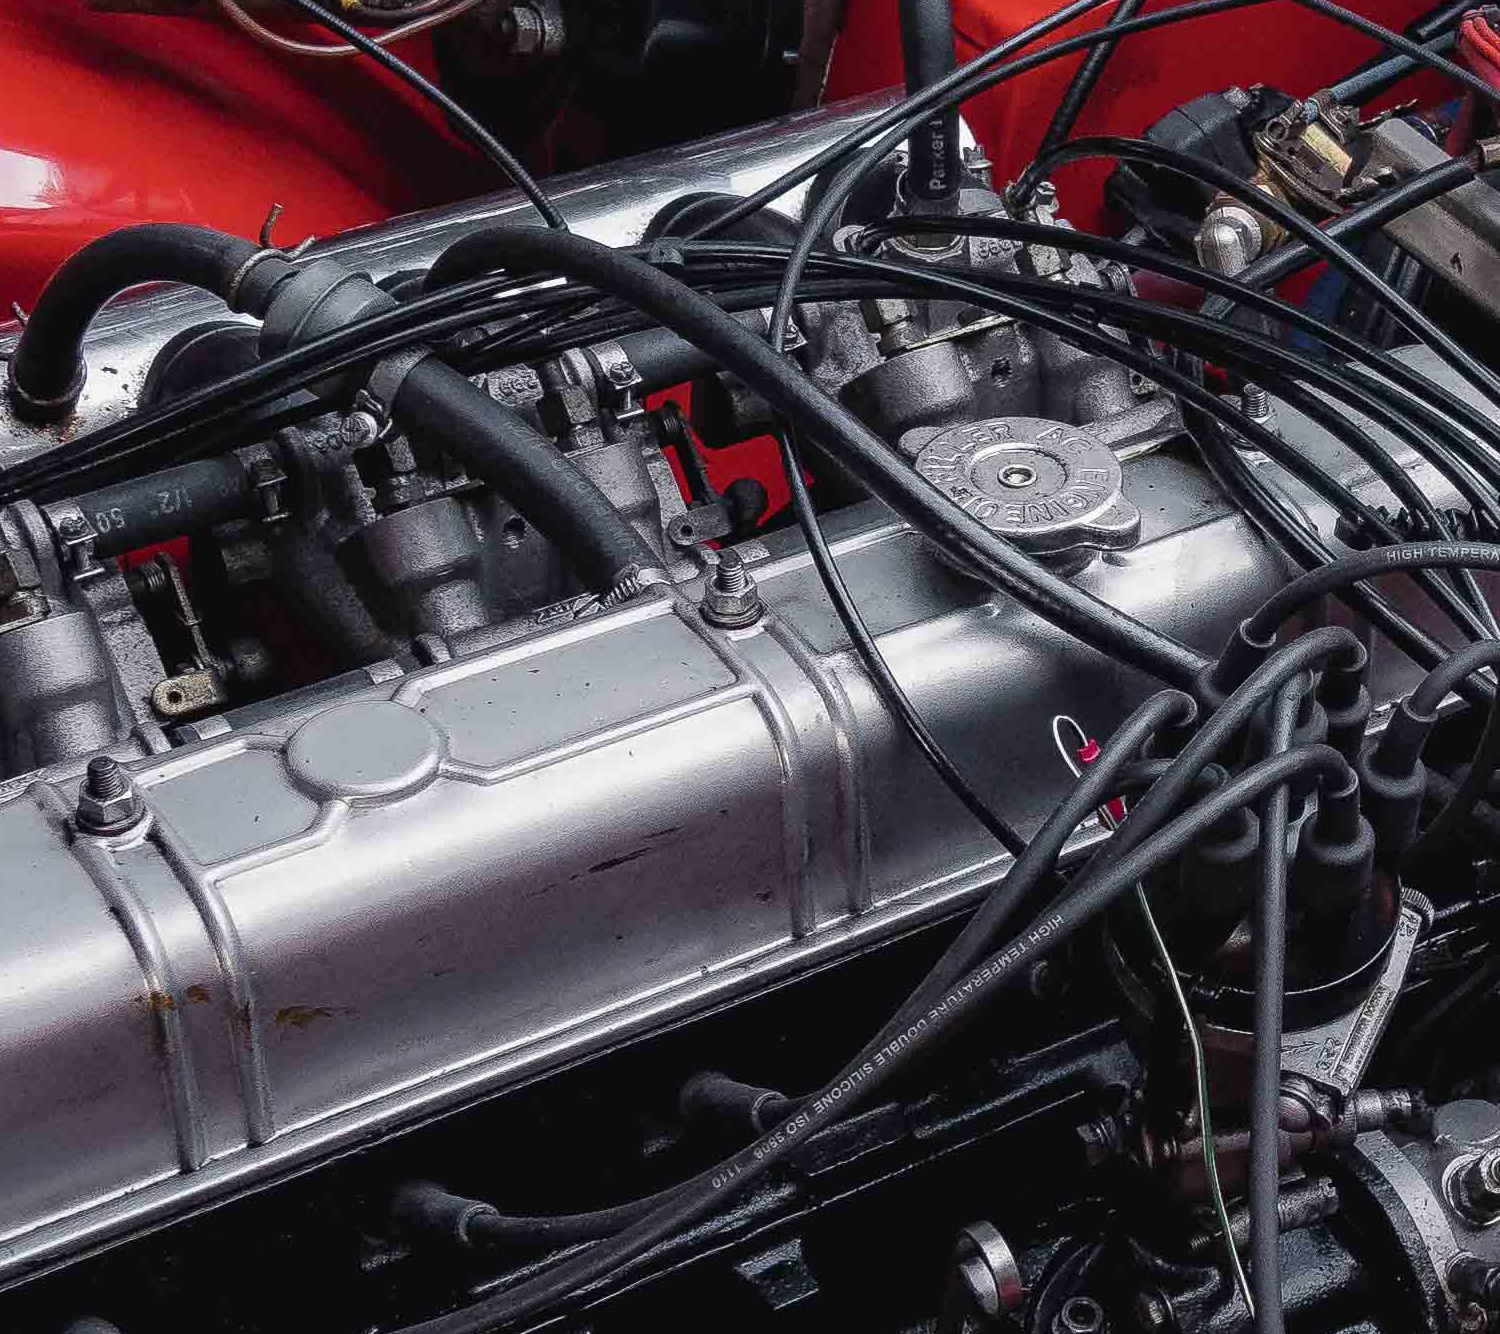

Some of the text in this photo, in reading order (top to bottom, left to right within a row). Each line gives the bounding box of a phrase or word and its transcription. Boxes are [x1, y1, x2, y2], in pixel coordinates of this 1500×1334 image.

[929, 131, 947, 190] Parker
[1007, 467, 1111, 525] ENGINE
[1026, 913, 1064, 945] HIGH
[926, 940, 1028, 1022] TEMPERATURE
[872, 1018, 928, 1066] DOUBLE
[810, 1059, 875, 1115] SILICONE
[784, 1111, 810, 1135] ISO
[710, 1162, 741, 1189] 1110
